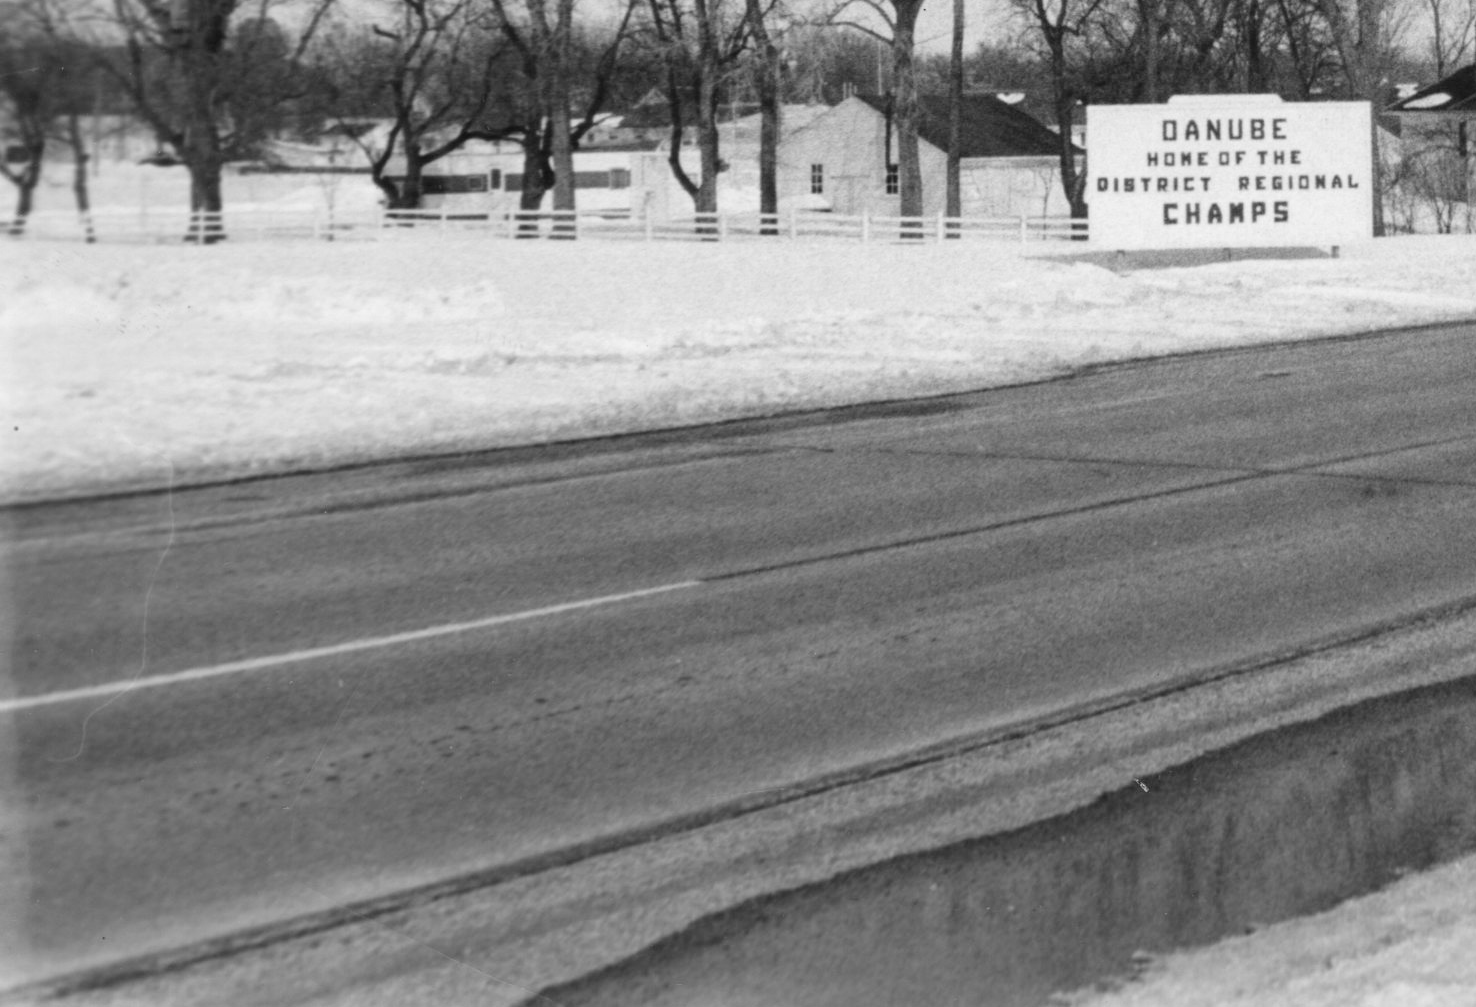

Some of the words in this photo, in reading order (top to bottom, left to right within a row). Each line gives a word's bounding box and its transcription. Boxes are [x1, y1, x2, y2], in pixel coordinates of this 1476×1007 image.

[1162, 119, 1287, 141] DANUBE
[1147, 151, 1208, 167] HOME
[1219, 151, 1246, 166] OF
[1257, 150, 1302, 165] THE
[1097, 177, 1212, 192] DISTRICT
[1238, 174, 1360, 190] REGIONAL
[1163, 201, 1290, 225] CHAMPS
